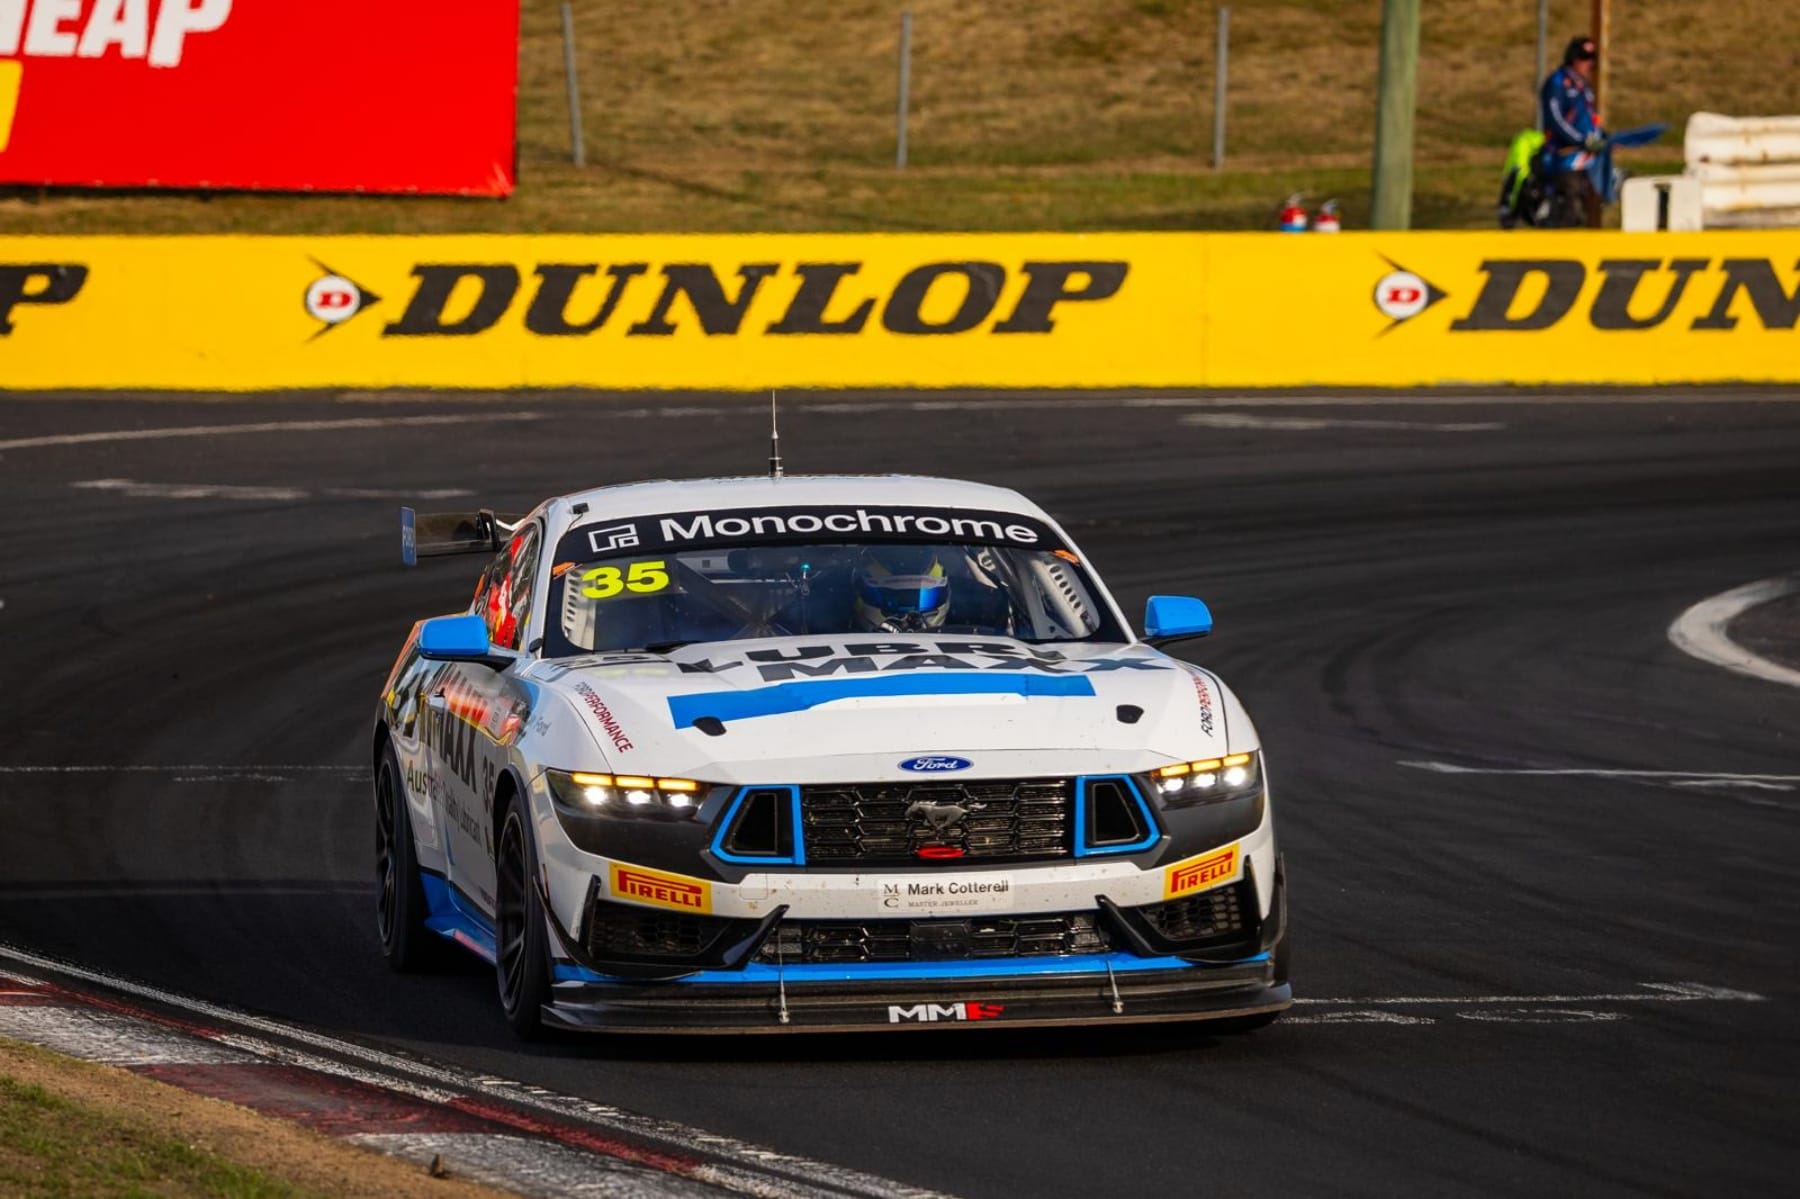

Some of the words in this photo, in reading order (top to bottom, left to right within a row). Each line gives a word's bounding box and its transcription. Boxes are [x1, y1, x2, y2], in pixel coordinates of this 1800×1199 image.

[382, 261, 1131, 336] DUNLOP
[659, 509, 1040, 544] Monochrome
[581, 560, 669, 599] 35
[912, 756, 959, 770] Ford
[618, 869, 703, 908] PIRELLI
[907, 883, 945, 896] Mark
[948, 879, 1009, 895] Cotterell
[1171, 850, 1234, 893] PIRELLI
